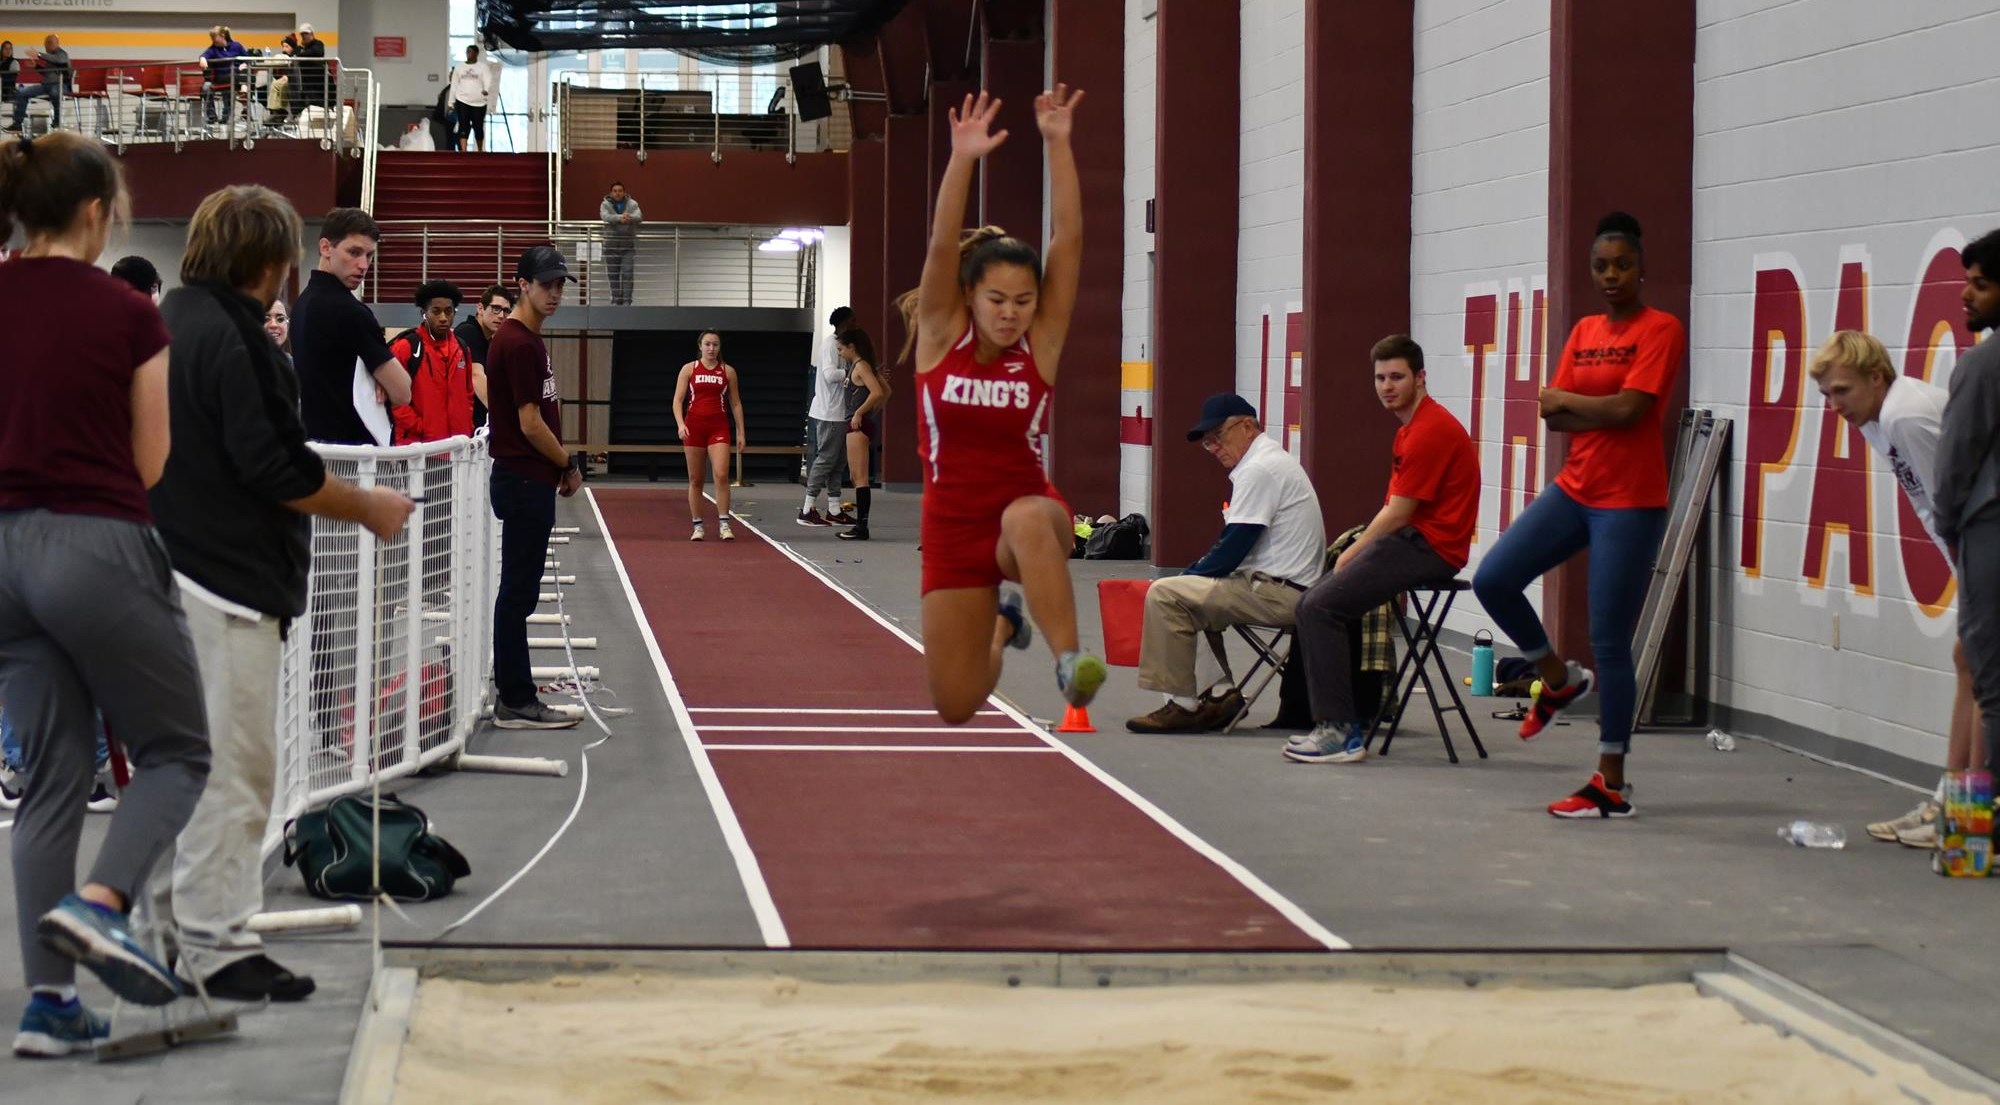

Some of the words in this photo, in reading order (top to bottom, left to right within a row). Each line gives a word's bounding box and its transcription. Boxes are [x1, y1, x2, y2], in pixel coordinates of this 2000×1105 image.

[695, 375, 723, 385] KING'S
[941, 374, 1029, 409] KING'S
[1464, 288, 1549, 545] TH
